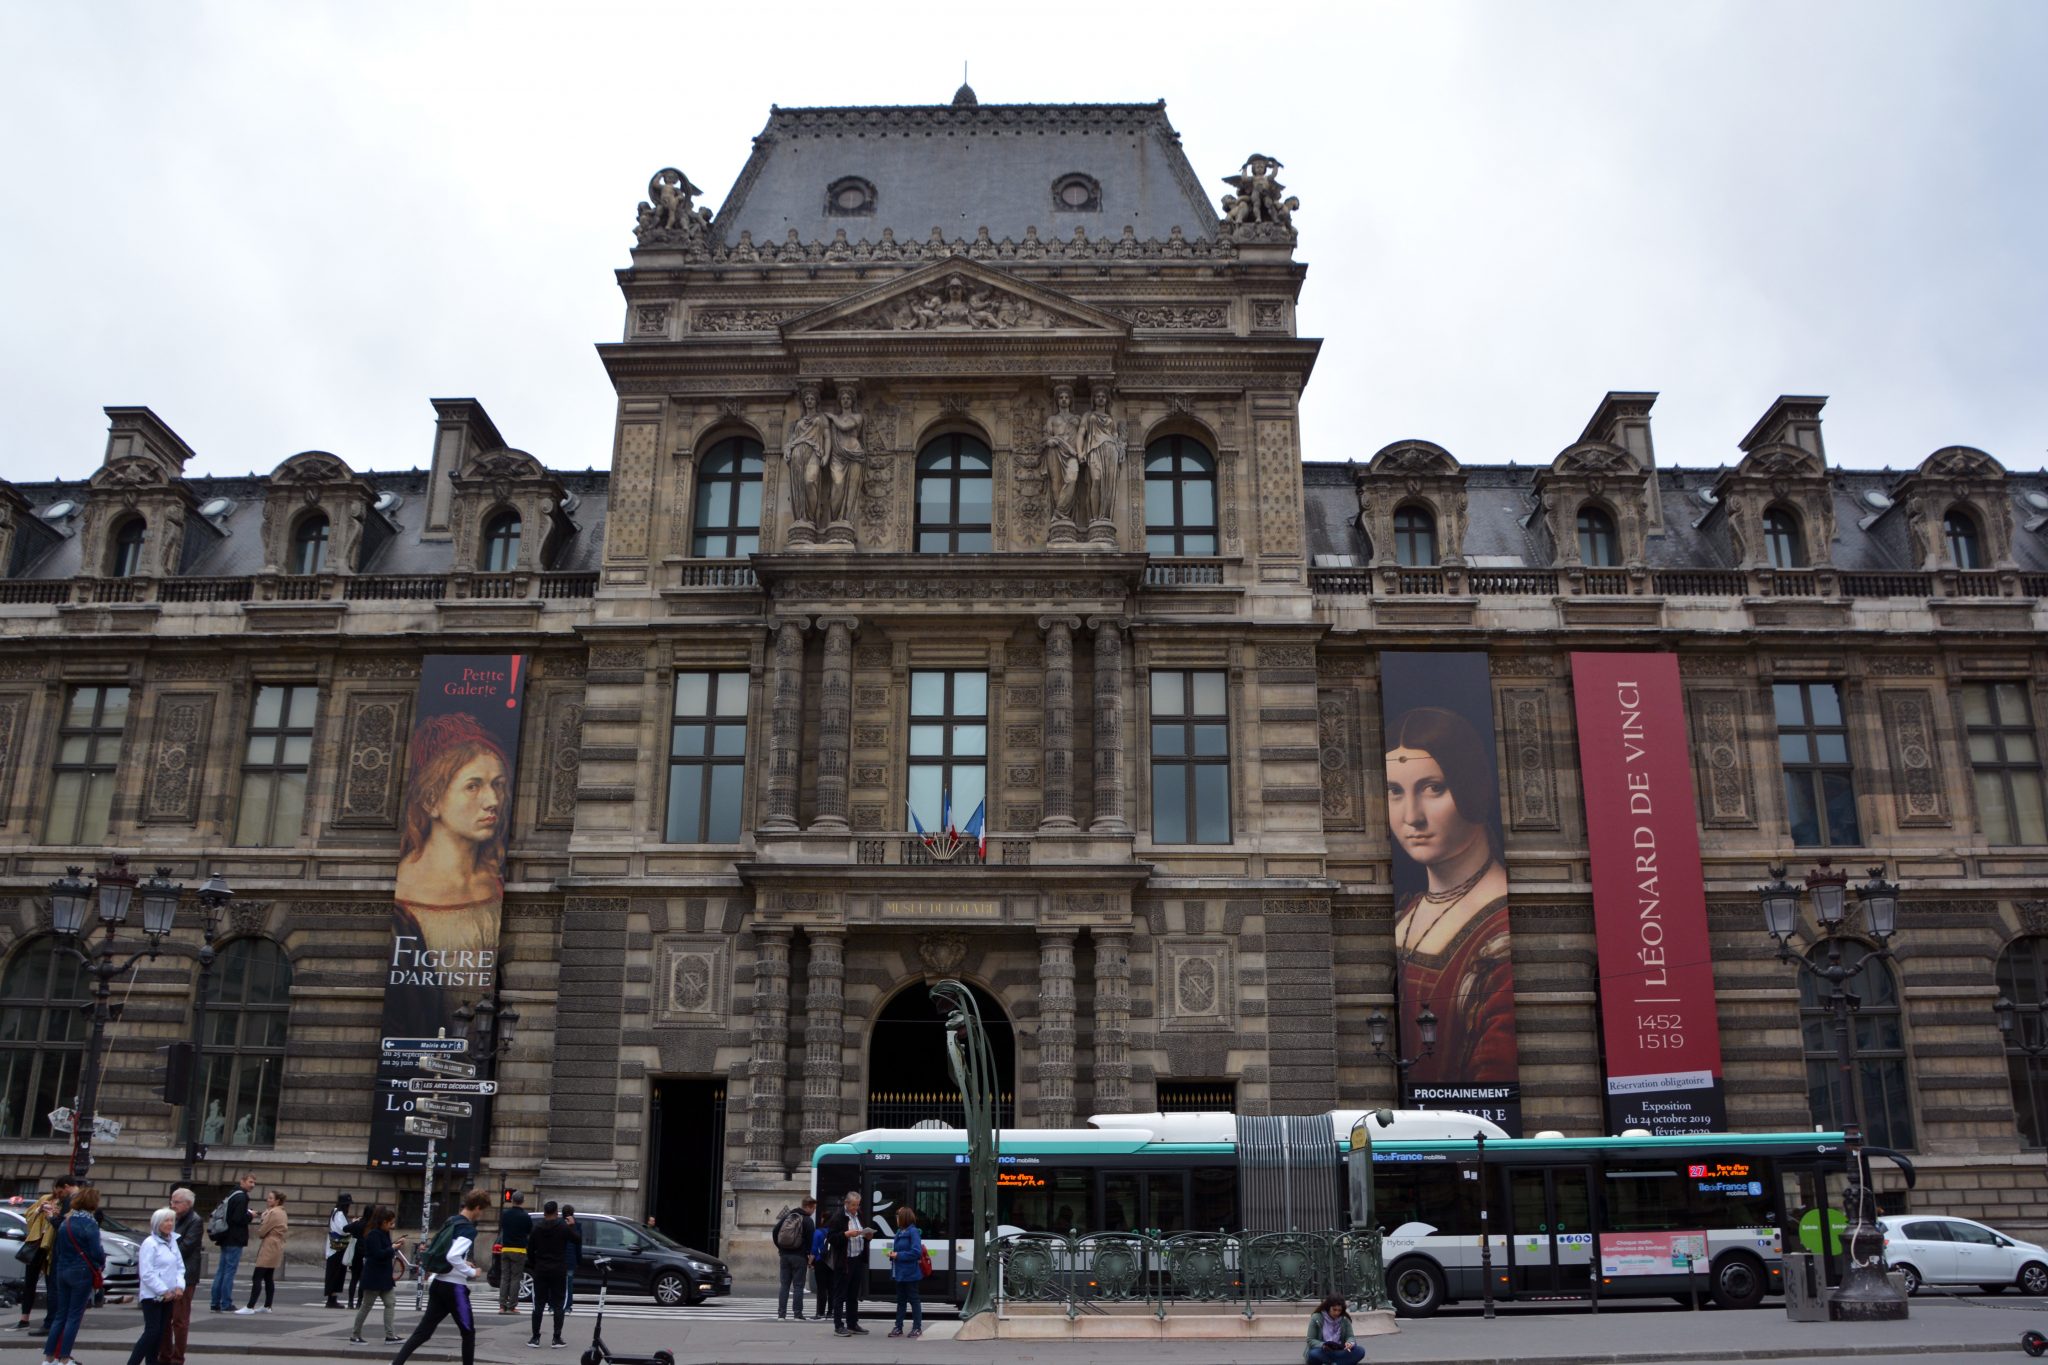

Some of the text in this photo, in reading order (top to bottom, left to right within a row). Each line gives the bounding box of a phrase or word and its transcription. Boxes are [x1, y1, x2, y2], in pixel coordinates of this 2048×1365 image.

[1617, 681, 1667, 986] LÉONARD DE VINCI
[392, 935, 494, 967] FIGURE
[389, 970, 492, 986] D'ARTISTE
[1637, 1014, 1682, 1030] 1452
[1638, 1033, 1684, 1049] 1519
[1609, 1075, 1705, 1091] Réservation obligatoire
[1414, 1088, 1510, 1098] PROCHAINEMENT
[1641, 1101, 1692, 1114] Exposition
[1624, 1114, 1711, 1126] du 24 octobre 2019
[1655, 1126, 1687, 1136] février
[1691, 1165, 1704, 1176] 27
